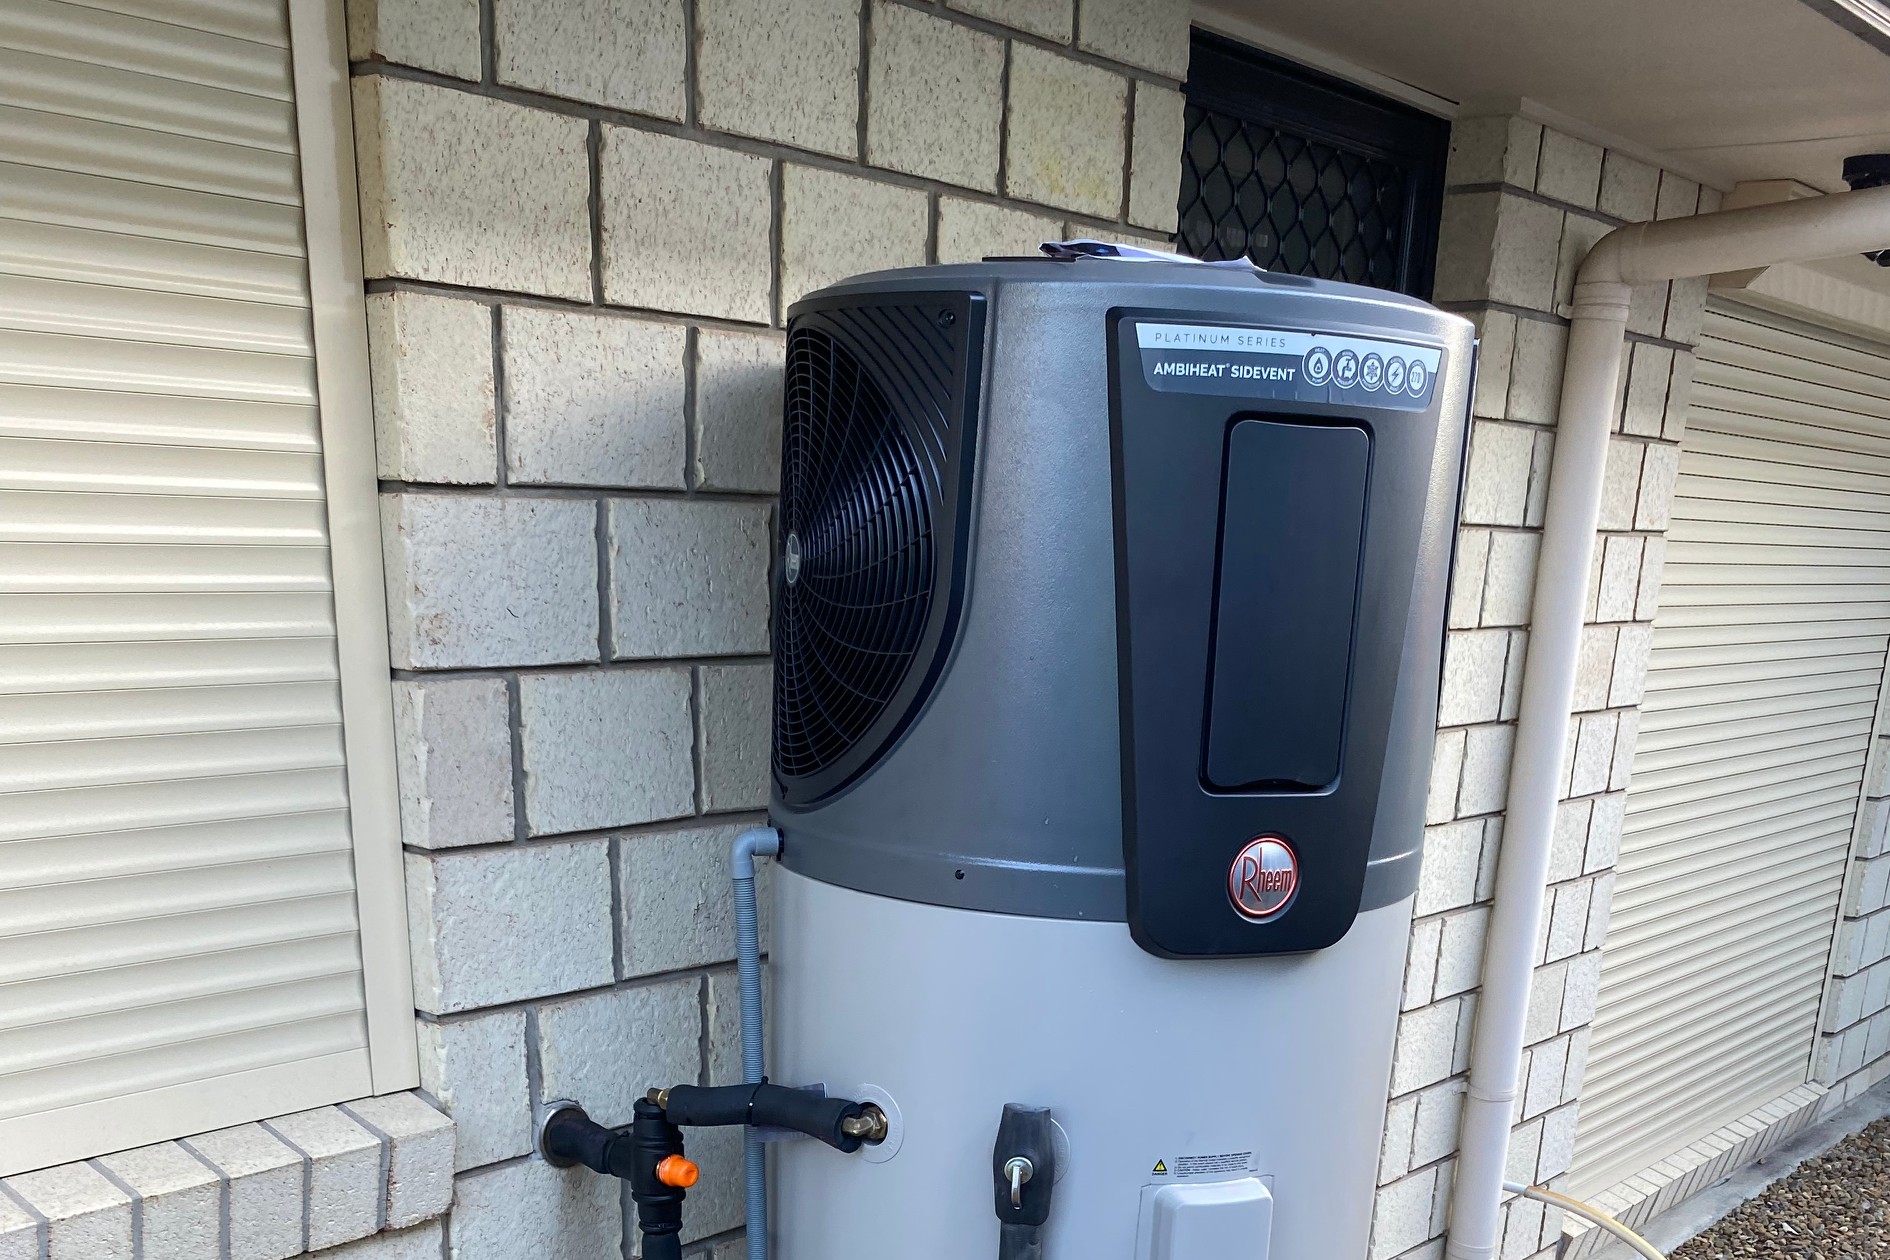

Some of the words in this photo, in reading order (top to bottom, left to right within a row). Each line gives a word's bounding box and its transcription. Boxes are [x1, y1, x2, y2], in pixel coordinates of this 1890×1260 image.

[1155, 332, 1230, 345] PLATINUM
[1238, 335, 1287, 348] SERIES
[1230, 366, 1296, 382] SIDEVENT
[1239, 847, 1294, 903] Rheem
